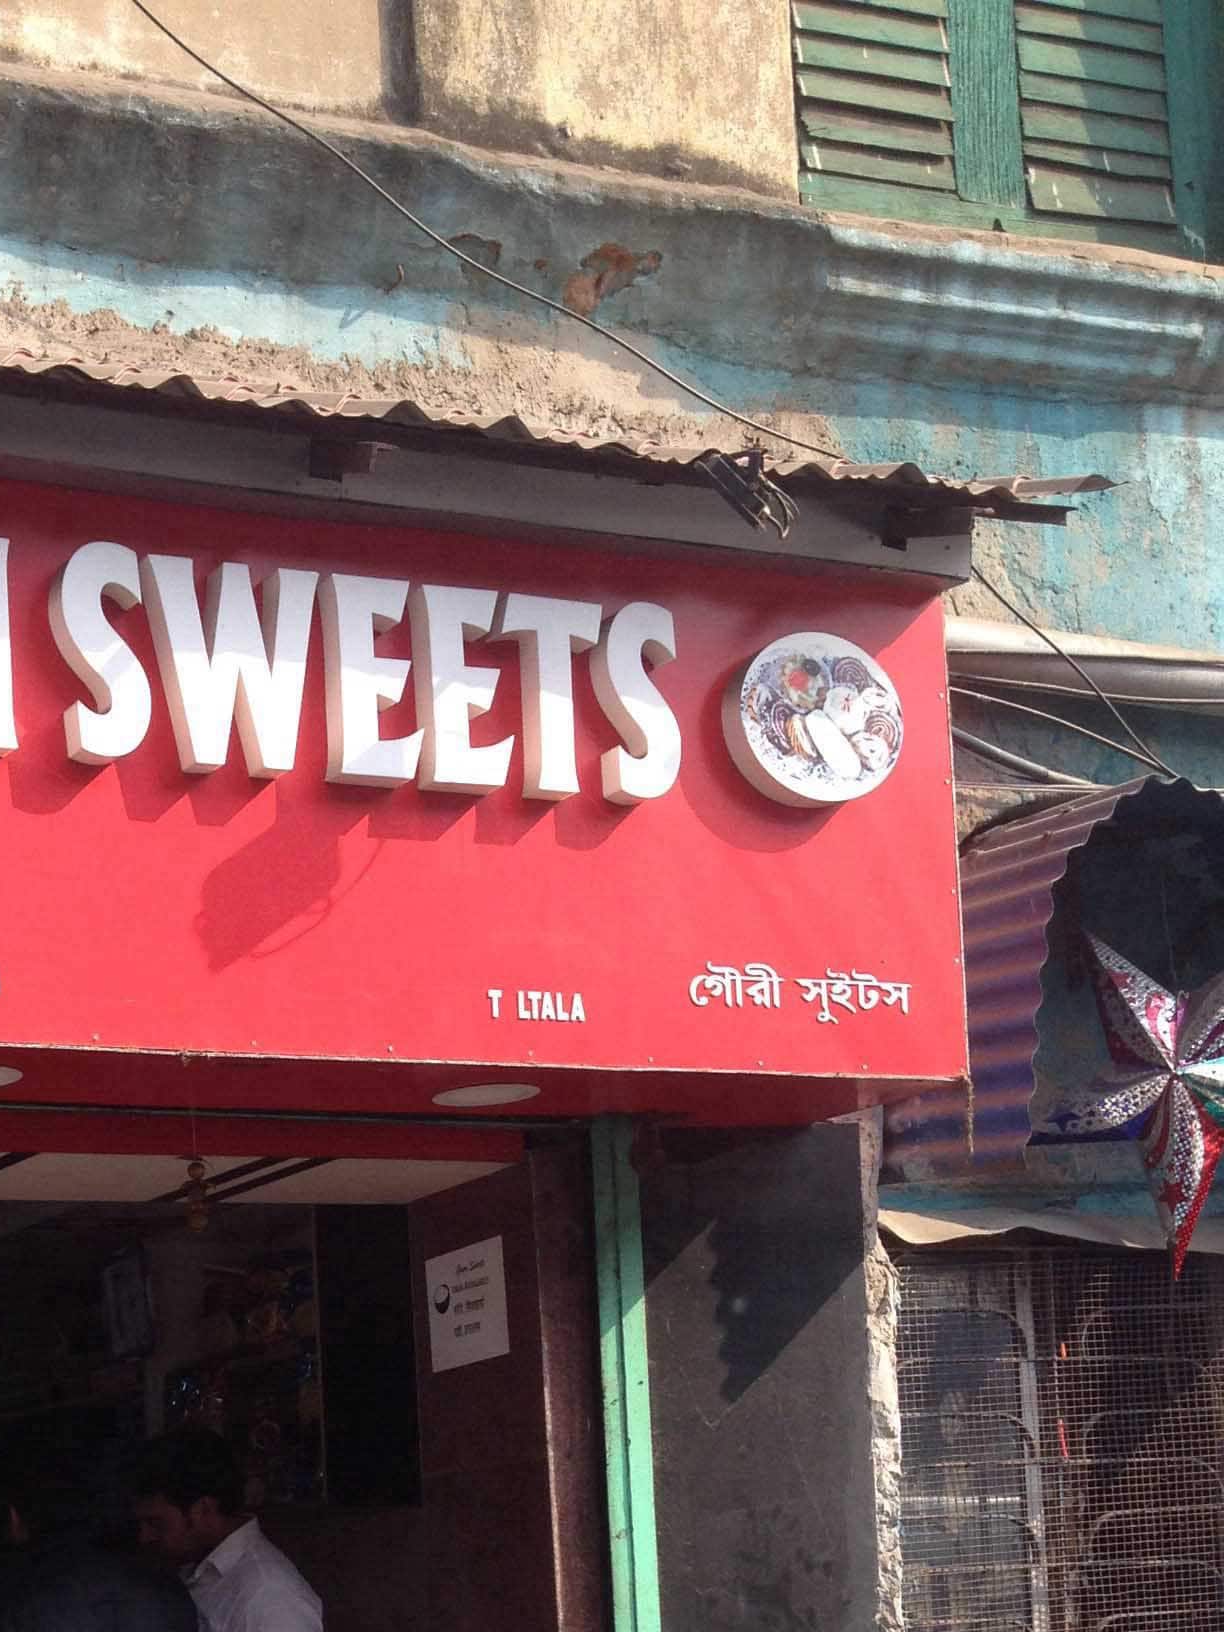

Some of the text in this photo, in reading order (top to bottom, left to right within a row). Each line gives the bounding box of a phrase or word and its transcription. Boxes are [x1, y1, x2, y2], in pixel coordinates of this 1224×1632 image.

[49, 540, 682, 804] SWEETS
[688, 961, 913, 1025] গৌরী সুইটস
